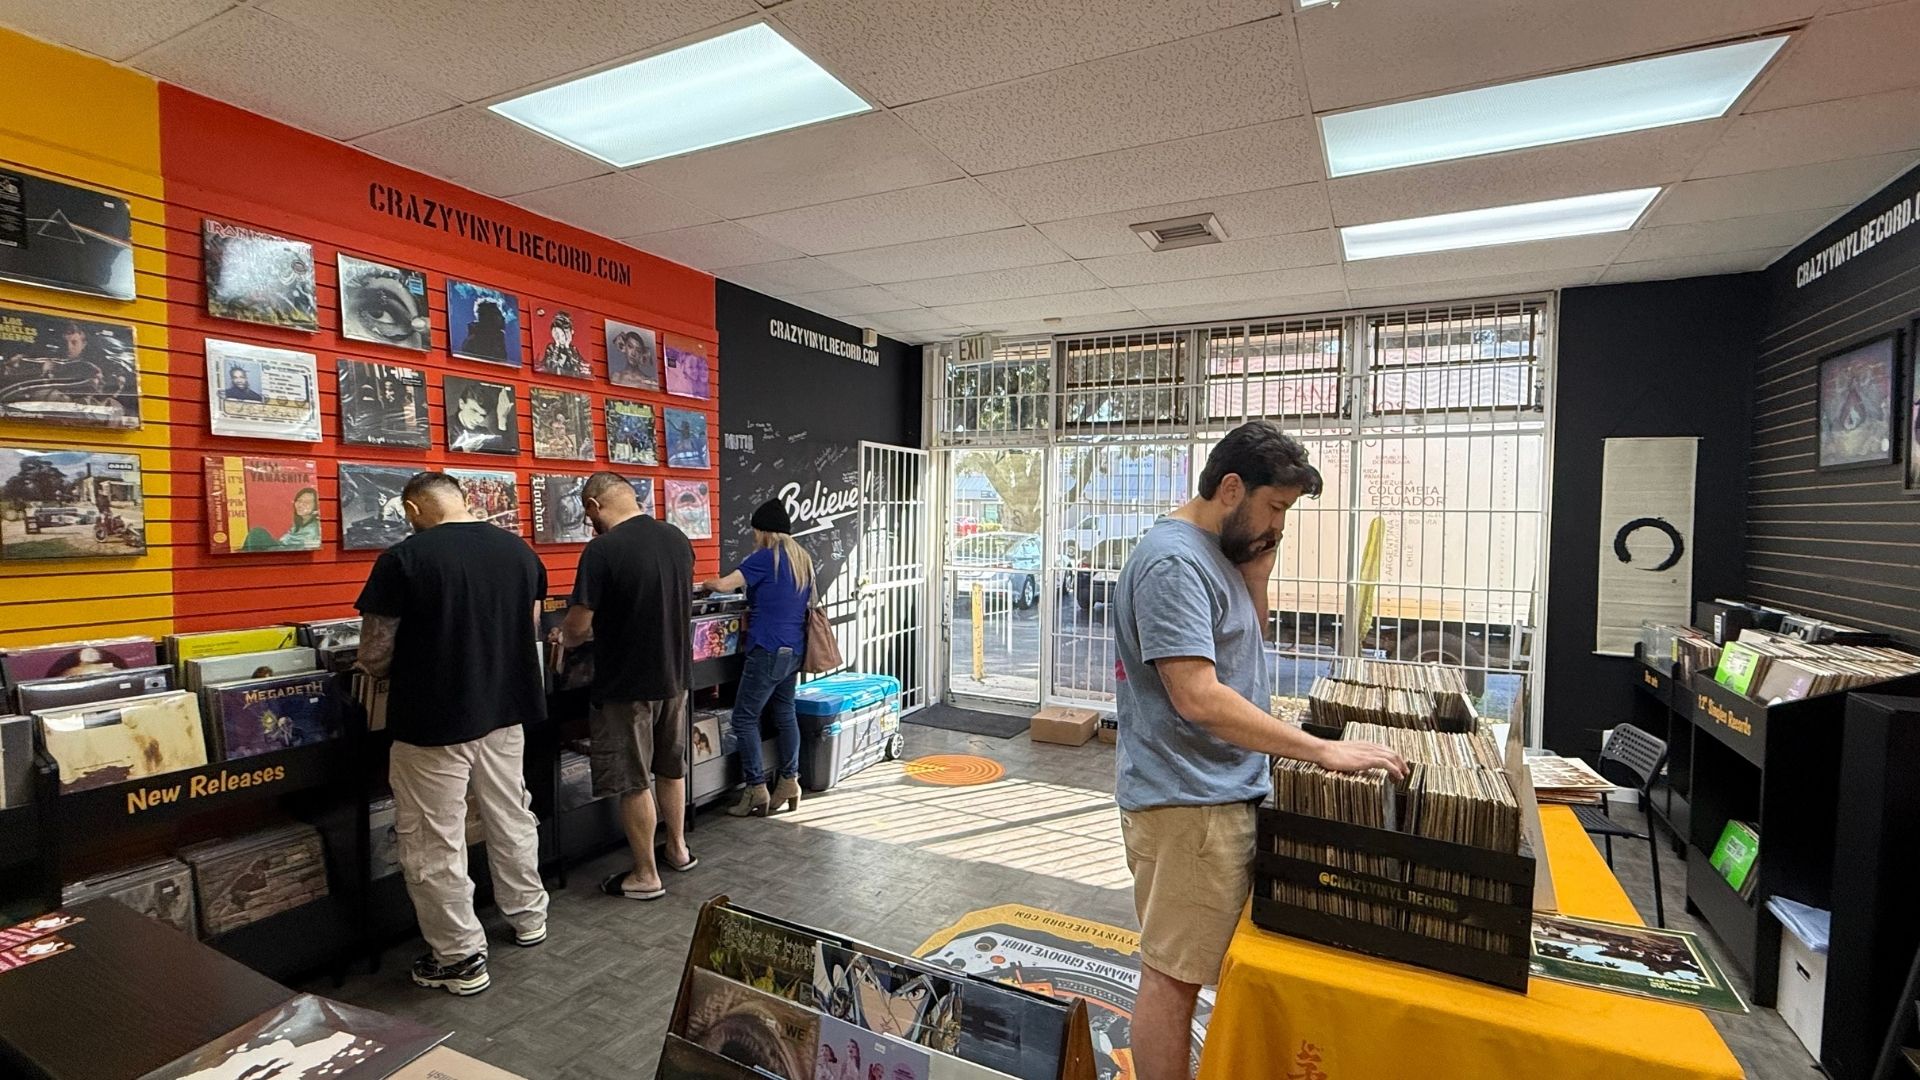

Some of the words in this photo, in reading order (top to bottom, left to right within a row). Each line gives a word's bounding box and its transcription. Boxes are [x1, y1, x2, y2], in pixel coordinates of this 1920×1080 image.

[205, 218, 248, 239] IRON
[369, 182, 632, 286] CRAZYVINYLRECORD.COM
[770, 319, 880, 367] CRAZYVINYLRECORD.COM
[959, 337, 985, 362] EXIT
[250, 471, 310, 483] YAMASHITA
[532, 476, 546, 533] Voodoo
[243, 680, 325, 707] MEGADETH
[1707, 698, 1728, 725] Singles
[1728, 710, 1752, 737] Records
[127, 784, 182, 814] New
[190, 764, 285, 799] Releases
[1030, 946, 1084, 969] GROOVE
[1084, 962, 1137, 984] MIAMI'S
[784, 1023, 806, 1041] WE
